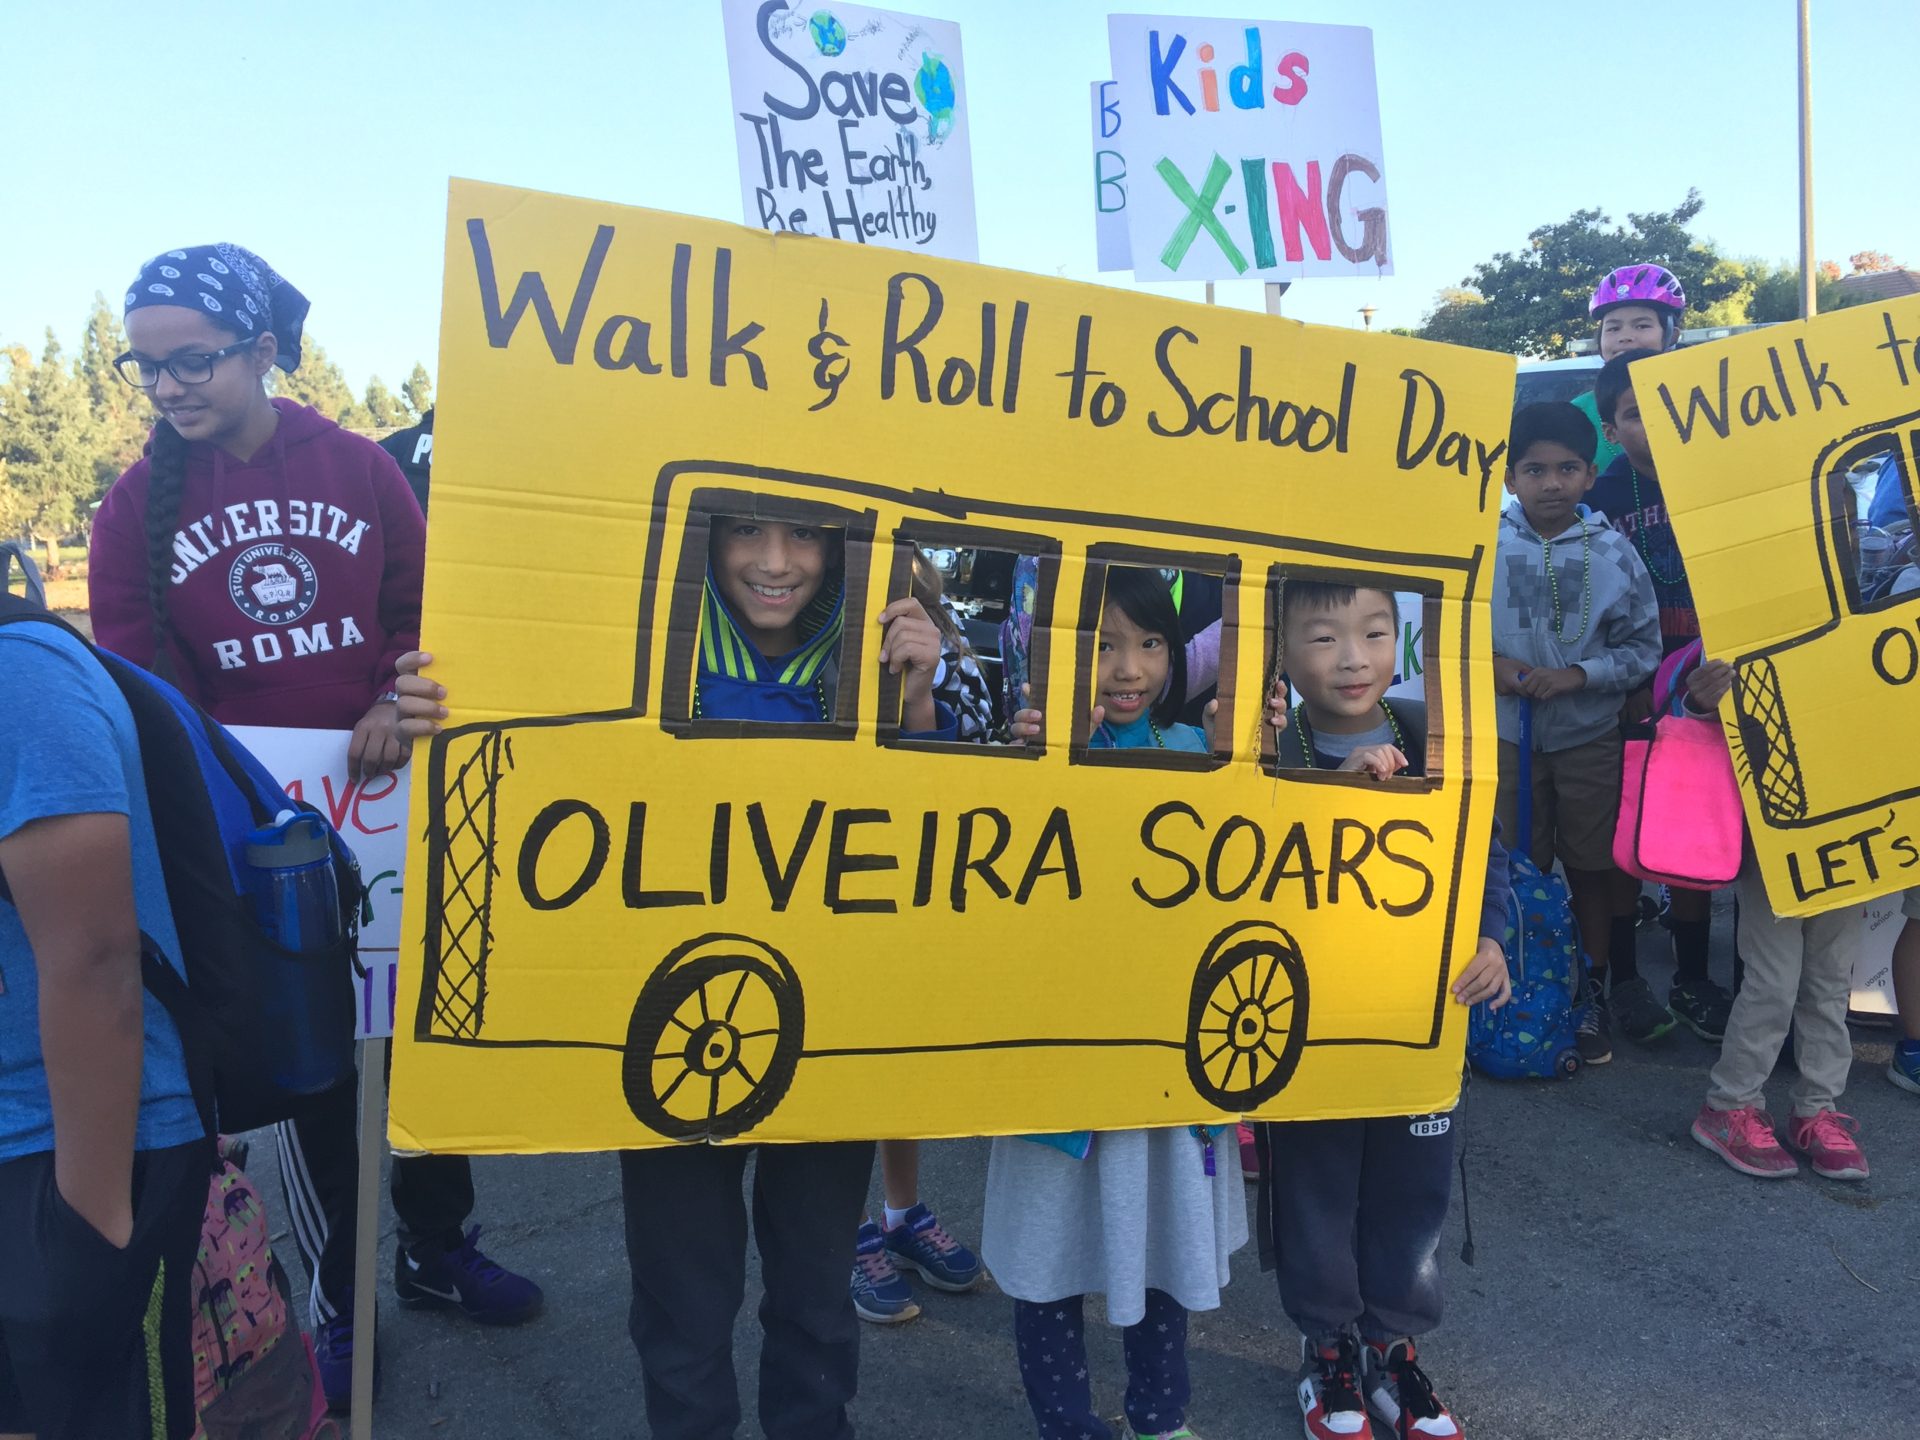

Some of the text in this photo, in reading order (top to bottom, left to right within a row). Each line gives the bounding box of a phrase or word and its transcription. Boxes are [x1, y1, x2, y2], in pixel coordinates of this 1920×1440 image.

[756, 0, 918, 124] Save
[1149, 27, 1310, 116] Kids
[740, 112, 932, 192] The Earth,
[823, 185, 936, 244] Healthy
[1156, 152, 1387, 276] X-ING
[466, 218, 1507, 513] Walk & Roll to School Day
[1657, 338, 1850, 444] Walk
[232, 563, 247, 597] STUDI
[255, 601, 309, 622] ROMA
[213, 616, 365, 670] ROMA
[517, 798, 1082, 914] OLIVEIRA
[1132, 801, 1435, 917] SOARS
[1786, 808, 1919, 903] LET'S
[1414, 1120, 1448, 1134] 1895
